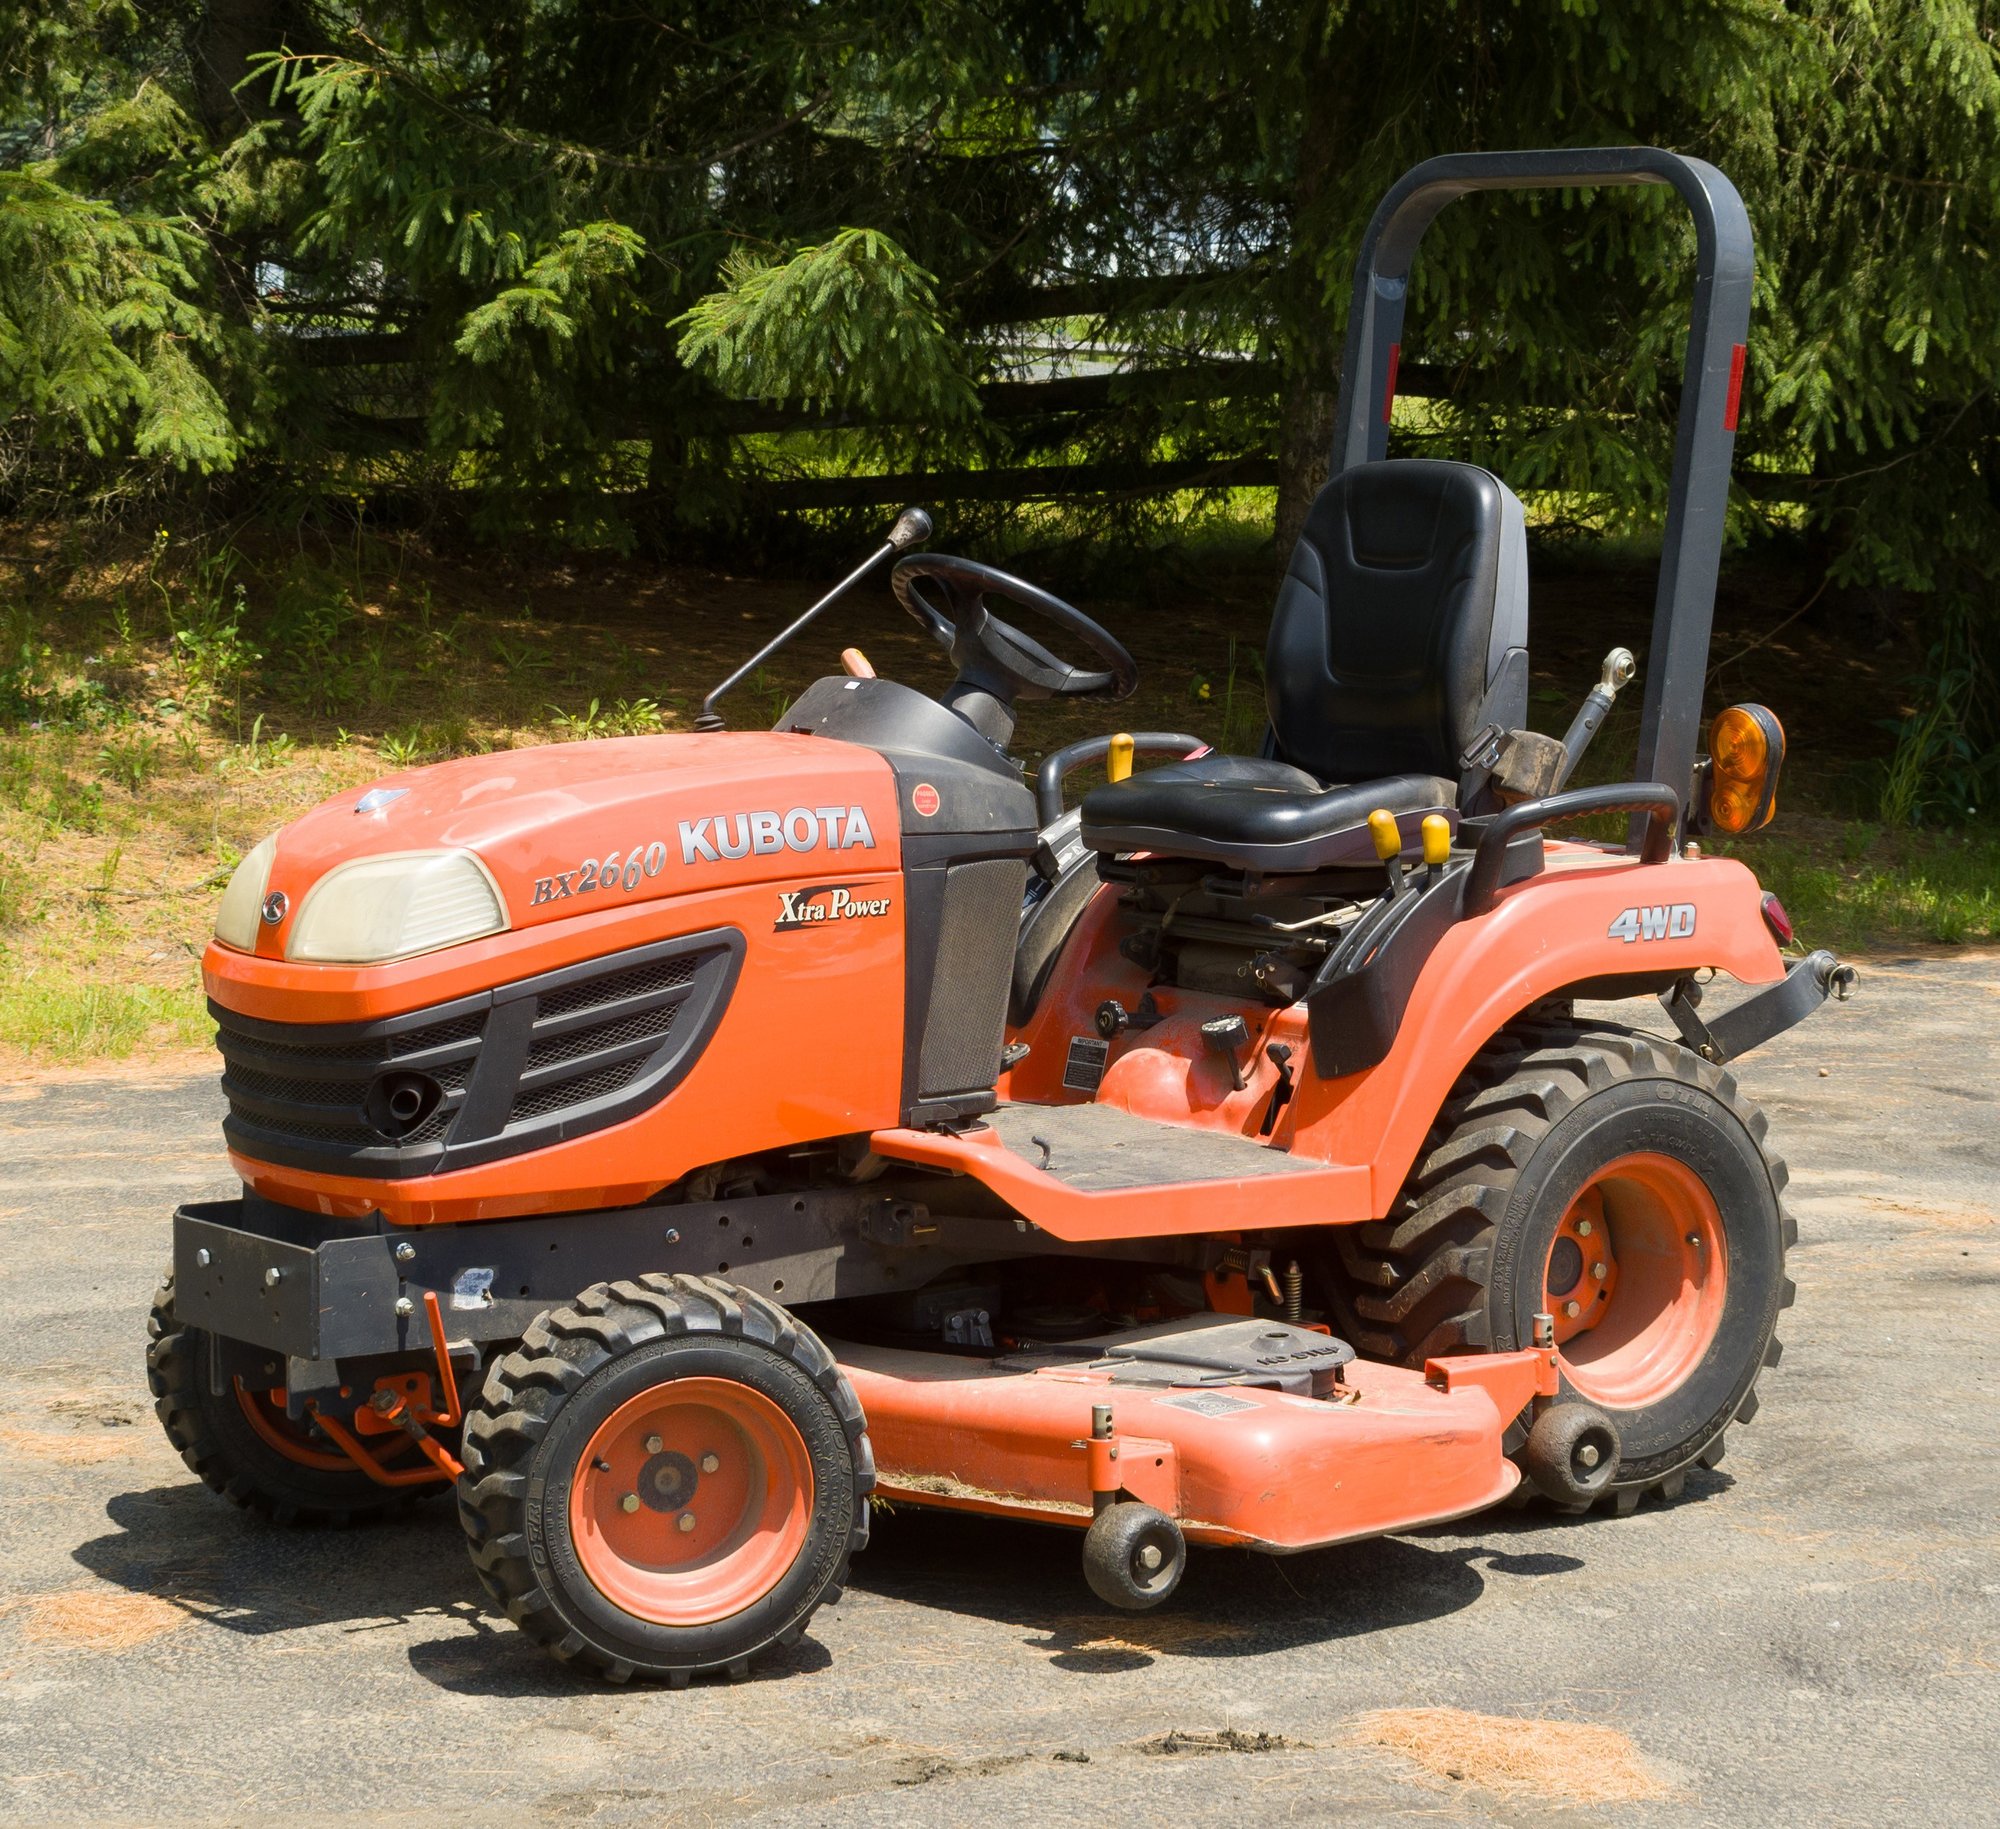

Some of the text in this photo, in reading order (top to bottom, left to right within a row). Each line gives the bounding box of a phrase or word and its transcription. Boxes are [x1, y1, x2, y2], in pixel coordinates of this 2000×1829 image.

[678, 807, 876, 865] KUBOTA
[530, 841, 667, 907] BX2660
[775, 888, 890, 923] Xtra Power
[1607, 902, 1697, 943] 4WD
[1655, 1082, 1712, 1115] OTR
[527, 1502, 547, 1566] OTR
